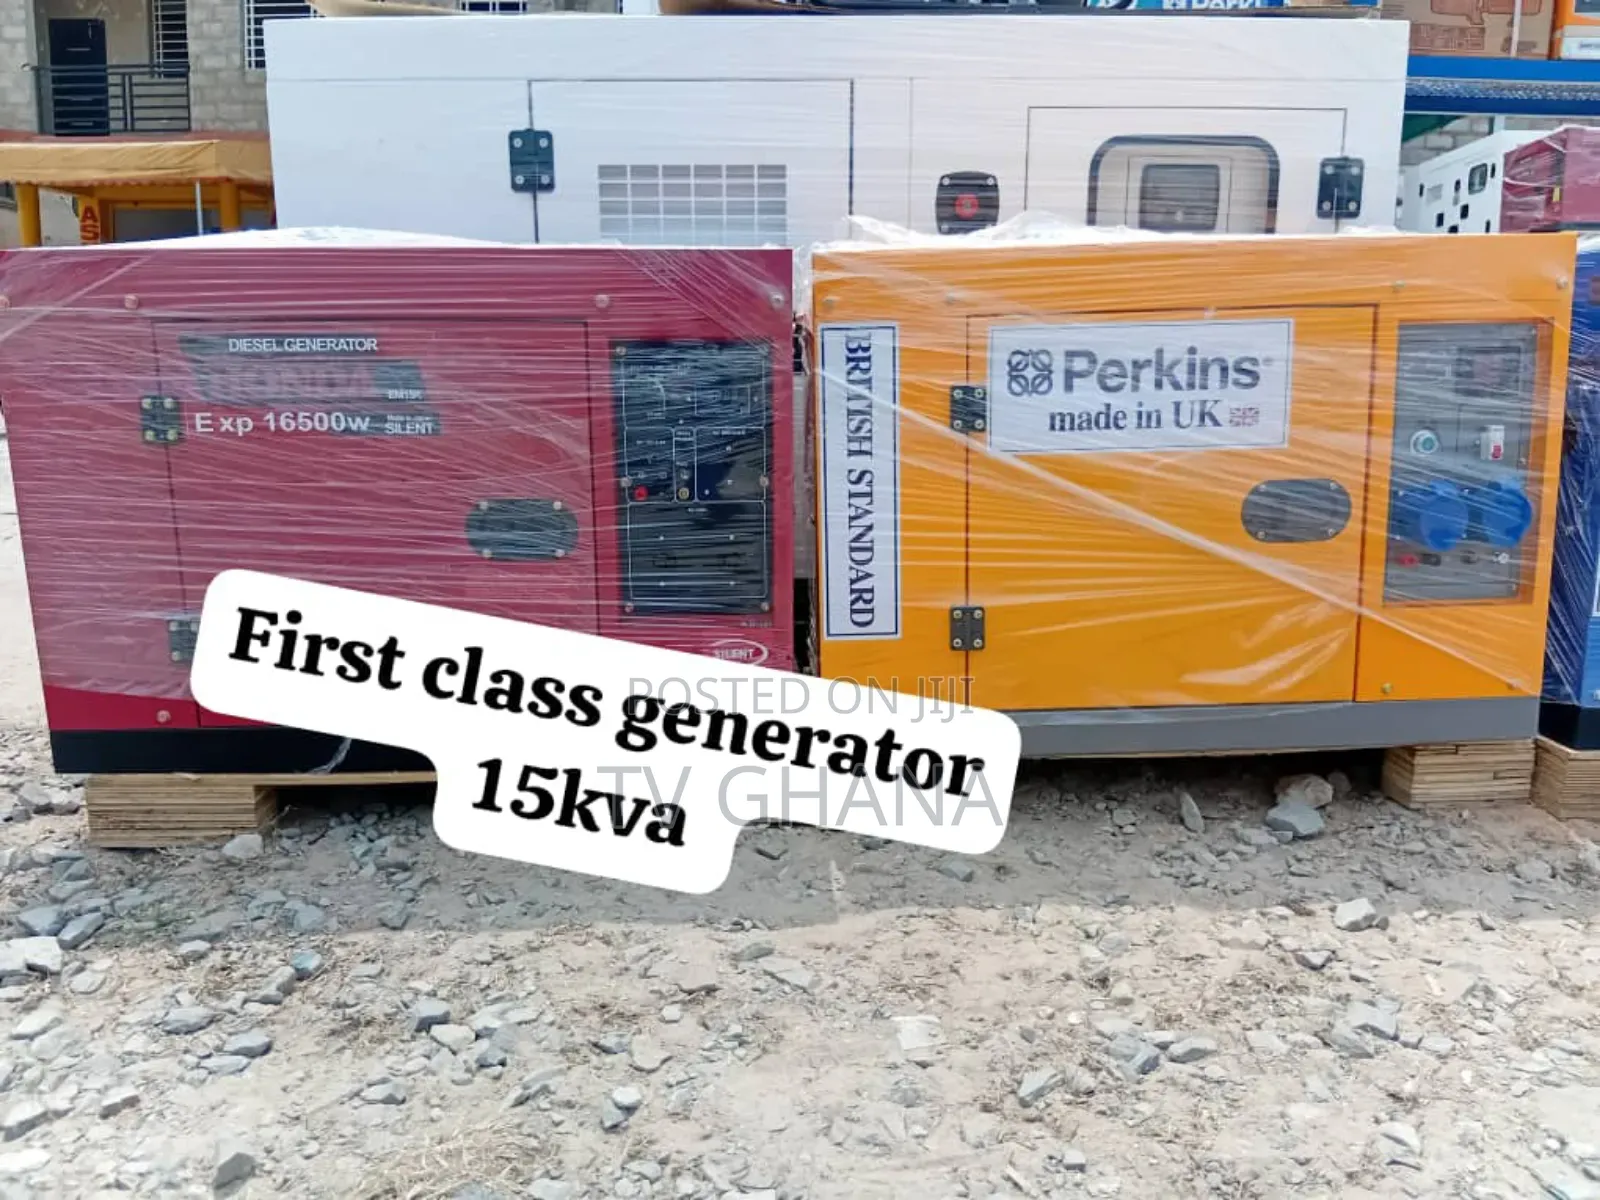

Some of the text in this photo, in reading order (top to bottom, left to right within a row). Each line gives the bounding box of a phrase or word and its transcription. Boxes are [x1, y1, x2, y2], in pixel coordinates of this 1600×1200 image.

[228, 337, 378, 352] DIESEL GENERATOR
[1063, 346, 1261, 394] Perkins
[263, 411, 370, 433] 16500w
[384, 421, 433, 434] SILENT
[1049, 399, 1223, 431] made in UK
[845, 333, 875, 628] BRITISH STANDARD
